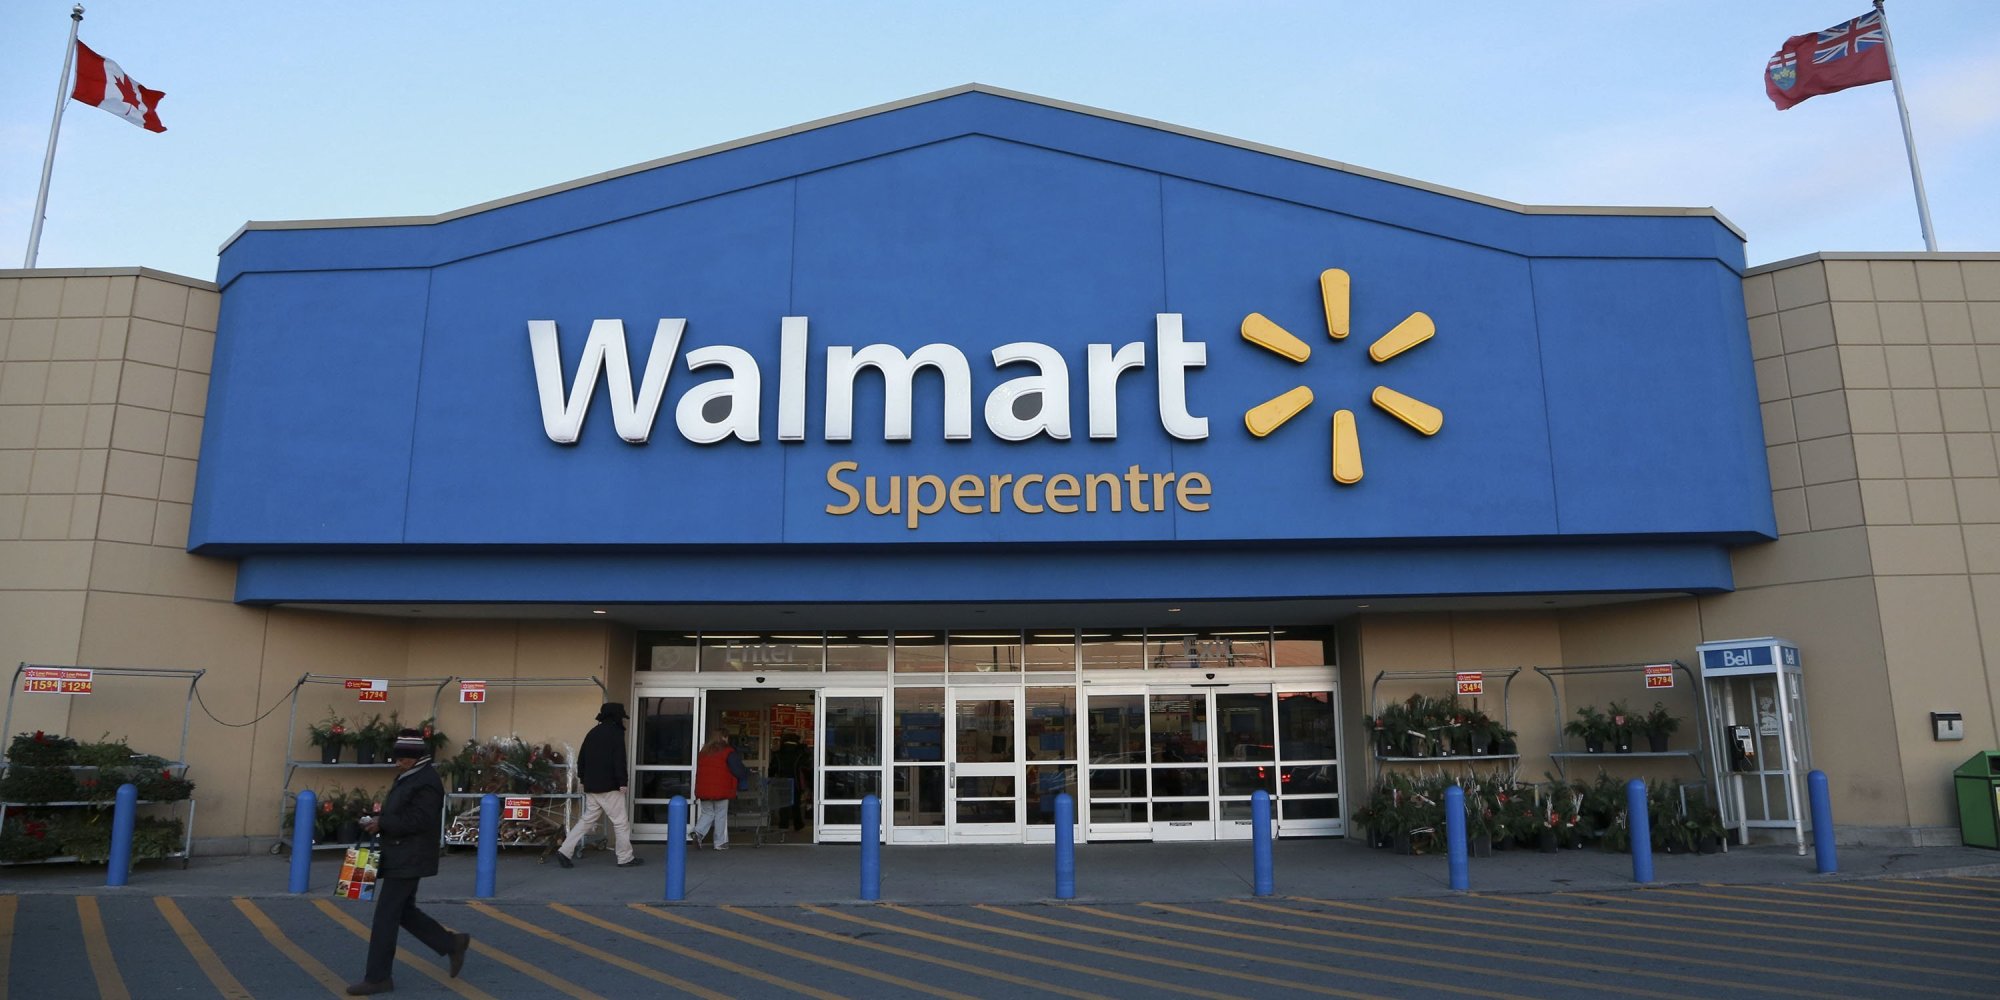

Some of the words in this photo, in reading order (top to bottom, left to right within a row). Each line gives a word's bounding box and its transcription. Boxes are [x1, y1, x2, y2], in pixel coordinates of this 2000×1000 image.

[528, 313, 1209, 443] Walmart
[825, 461, 1212, 528] Supercentre
[726, 639, 792, 663] Enter
[1184, 636, 1233, 659] Exit
[1723, 649, 1753, 667] Bell
[1784, 647, 1795, 665] Bell
